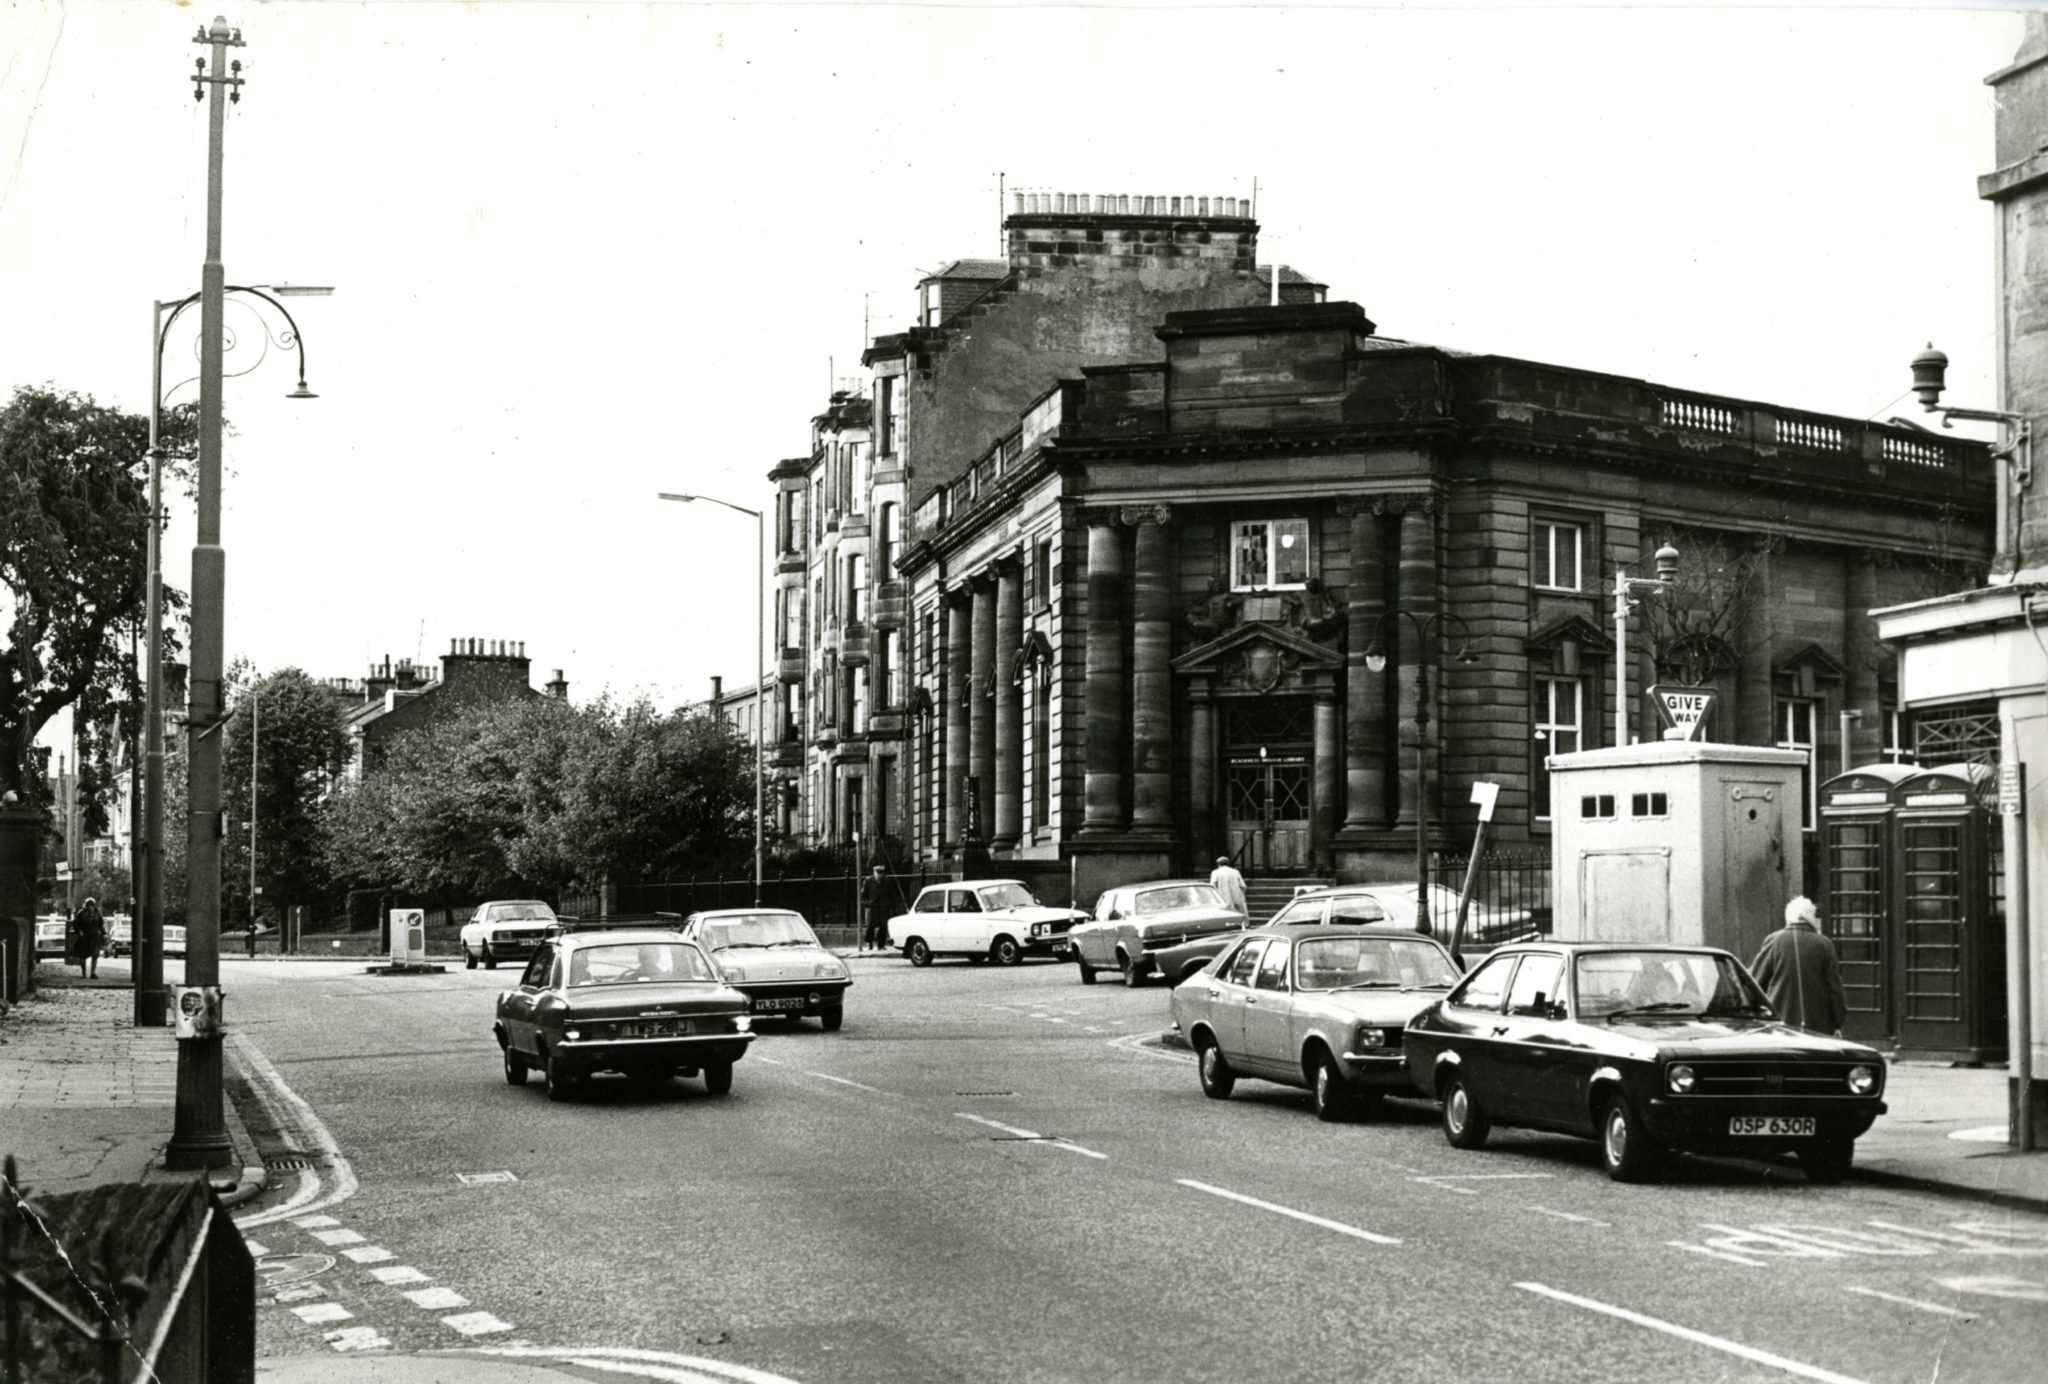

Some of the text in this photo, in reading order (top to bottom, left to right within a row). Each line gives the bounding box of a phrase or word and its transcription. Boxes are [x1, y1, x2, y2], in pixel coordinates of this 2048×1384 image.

[1667, 695, 1703, 711] GIVE
[1674, 713, 1700, 723] WAY
[1043, 926, 1049, 934] L
[1769, 1118, 1814, 1134] 630R
